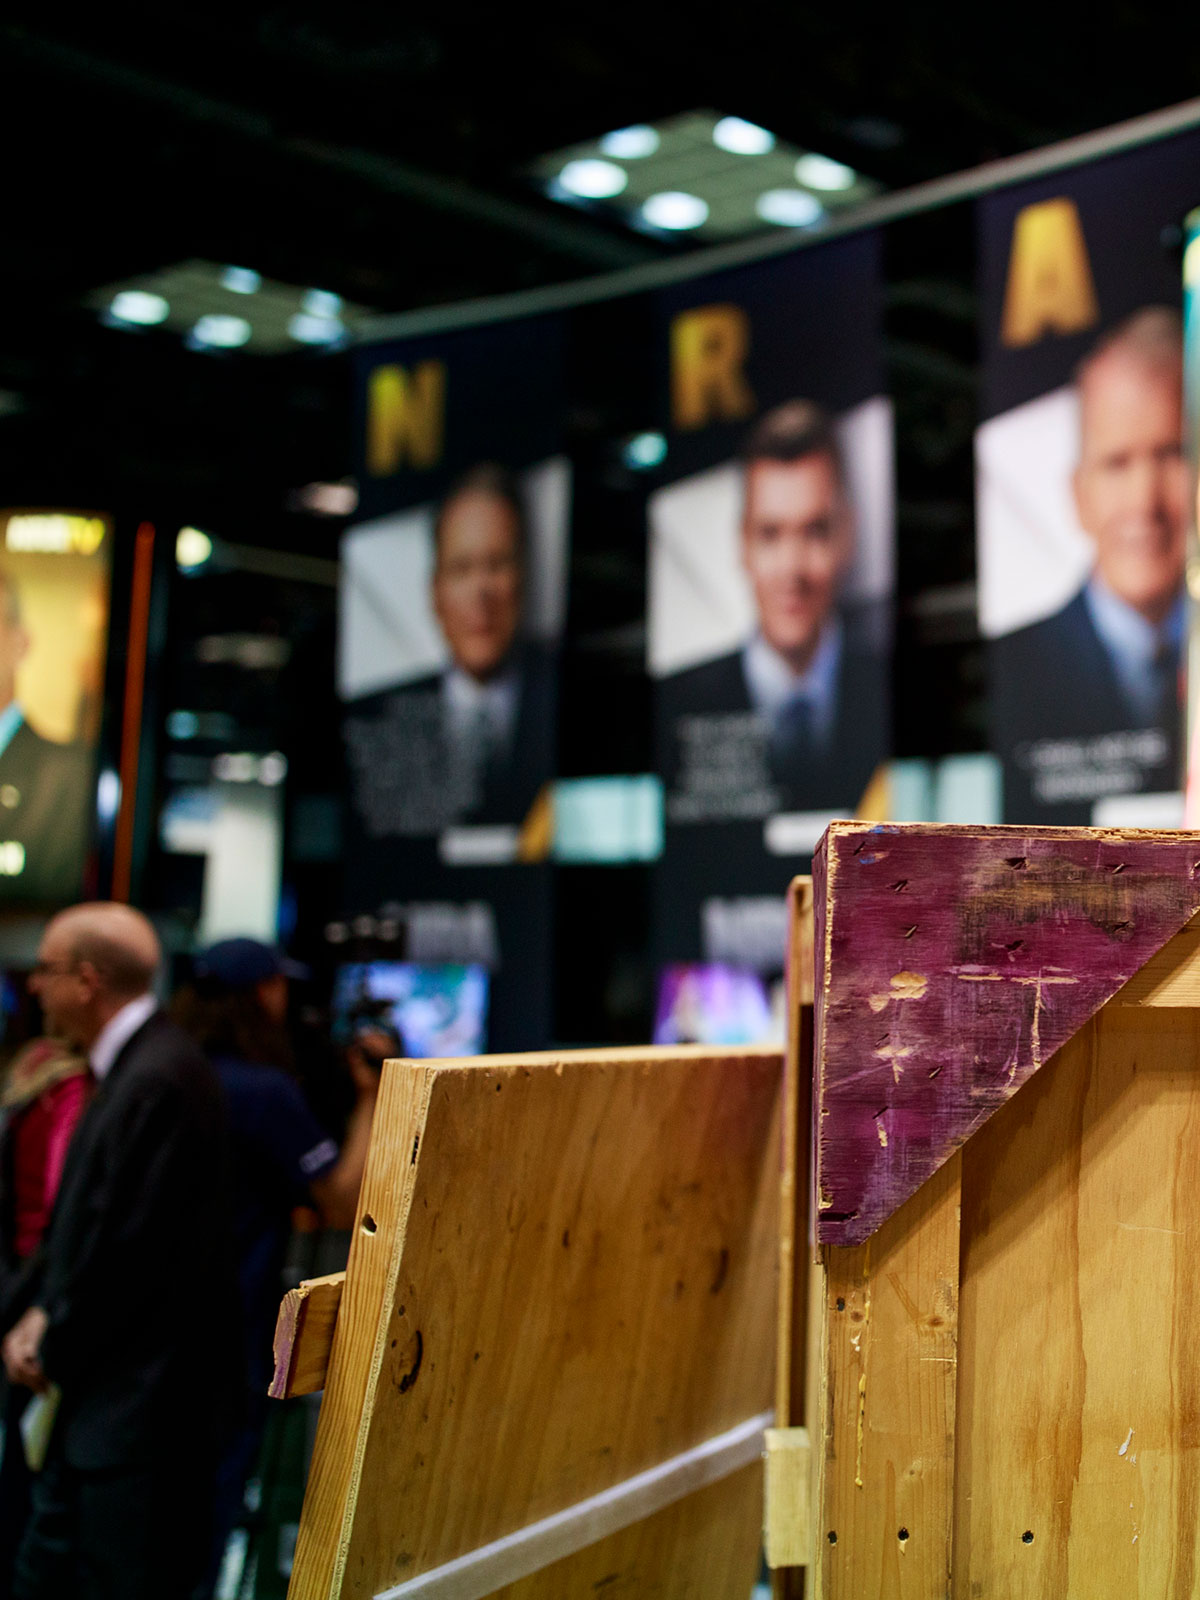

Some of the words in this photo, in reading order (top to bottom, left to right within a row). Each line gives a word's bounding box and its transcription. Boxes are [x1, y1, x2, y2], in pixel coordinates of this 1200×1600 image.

[1005, 196, 1098, 349] A
[367, 358, 446, 477] N
[670, 302, 753, 431] R
